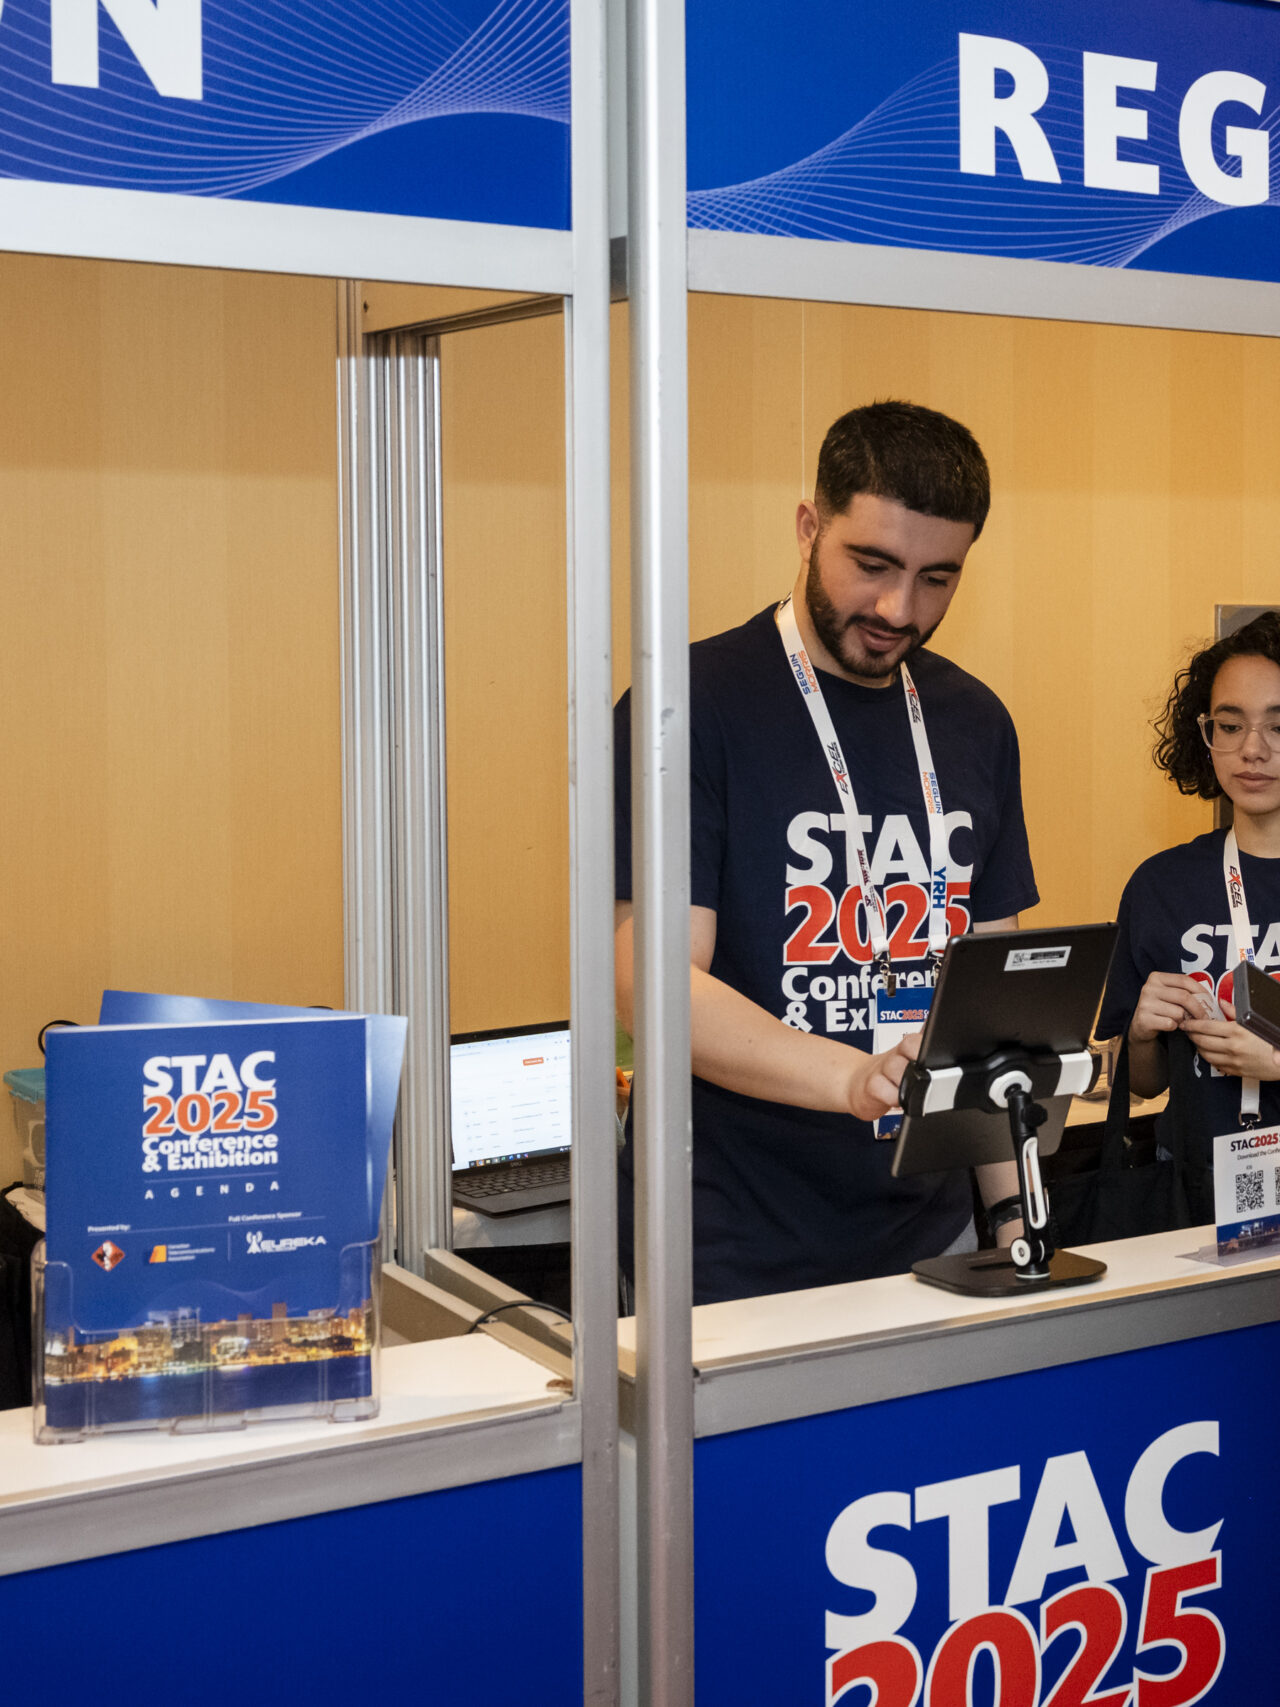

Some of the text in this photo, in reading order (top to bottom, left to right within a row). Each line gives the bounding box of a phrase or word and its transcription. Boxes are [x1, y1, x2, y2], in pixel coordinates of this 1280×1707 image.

[789, 653, 811, 695] SEGUIN
[798, 650, 819, 693] MORRIS
[827, 742, 849, 795] EXCEL
[922, 771, 935, 814] MORRIS
[929, 771, 942, 814] SEGUIN
[786, 810, 974, 885] STAC
[932, 866, 947, 909] YRH
[1228, 865, 1243, 907] EXCEL
[783, 881, 971, 965] 2025
[143, 1050, 277, 1096] STAC
[142, 1087, 278, 1138] 2025
[141, 1133, 279, 1155] Conference
[141, 1150, 279, 1173] & Exhibition
[825, 1420, 1224, 1650] STAC
